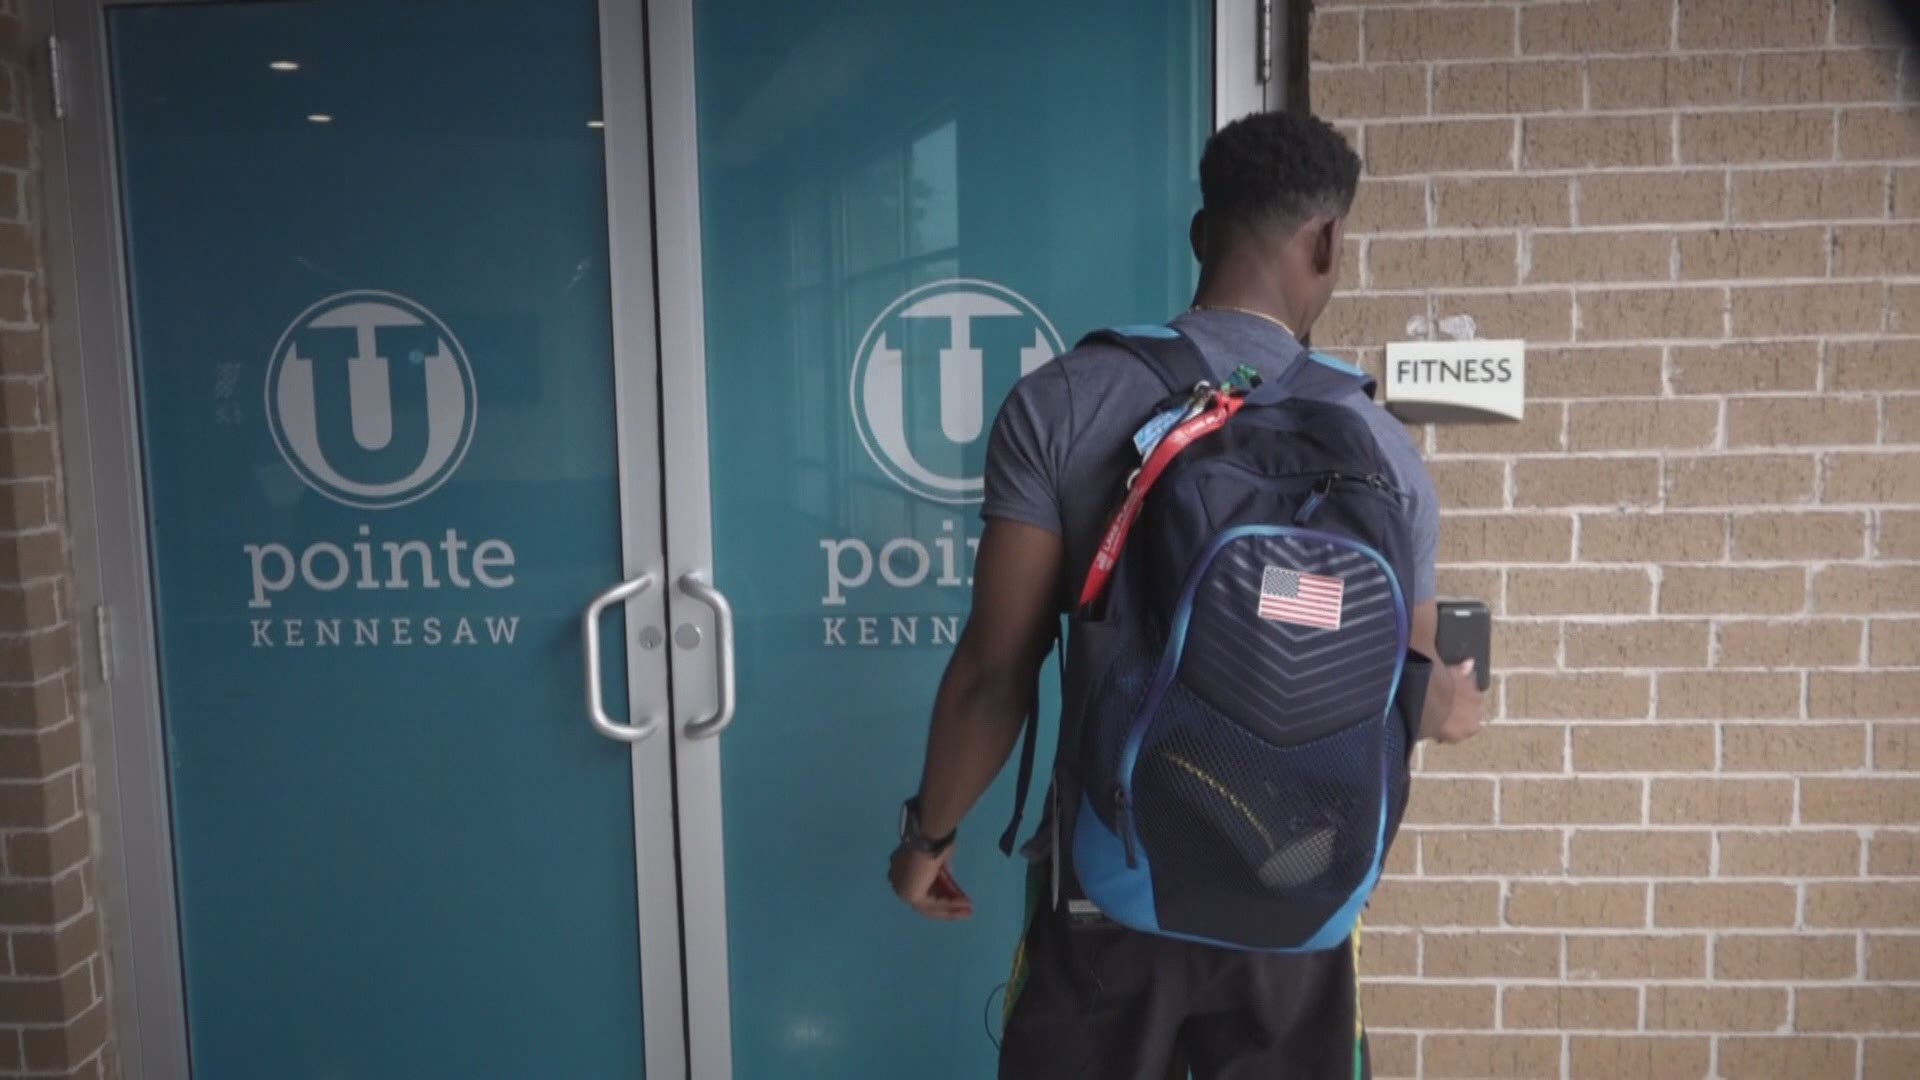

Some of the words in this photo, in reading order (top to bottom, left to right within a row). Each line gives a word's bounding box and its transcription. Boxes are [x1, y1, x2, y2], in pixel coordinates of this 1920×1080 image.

[1397, 358, 1512, 384] FITNESS
[243, 524, 516, 608] pointe
[819, 519, 981, 605] poi
[250, 616, 520, 647] KENNESAW
[822, 616, 959, 645] KENN
